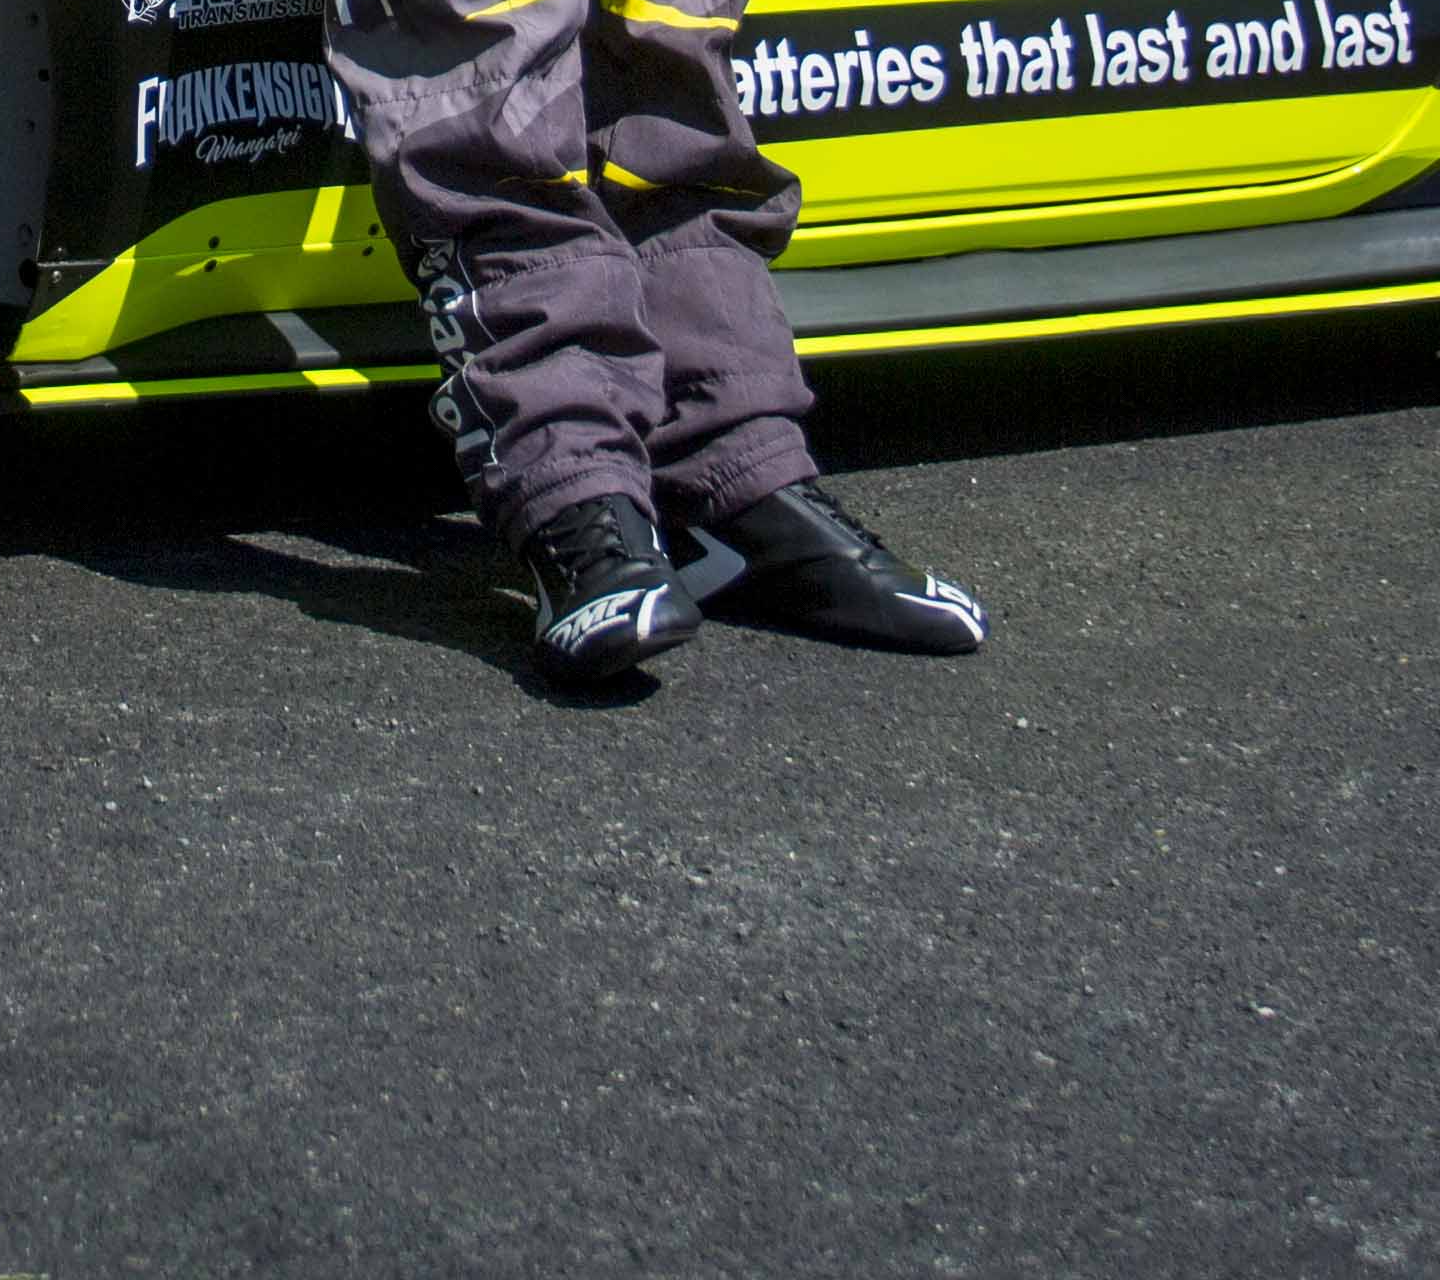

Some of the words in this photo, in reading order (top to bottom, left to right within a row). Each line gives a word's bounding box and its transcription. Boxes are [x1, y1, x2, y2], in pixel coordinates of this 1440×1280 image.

[135, 60, 358, 168] FRANKENSIGN
[732, 28, 947, 118] atteries
[960, 19, 1075, 99] that
[1087, 12, 1189, 90] last
[1205, 9, 1305, 78] and
